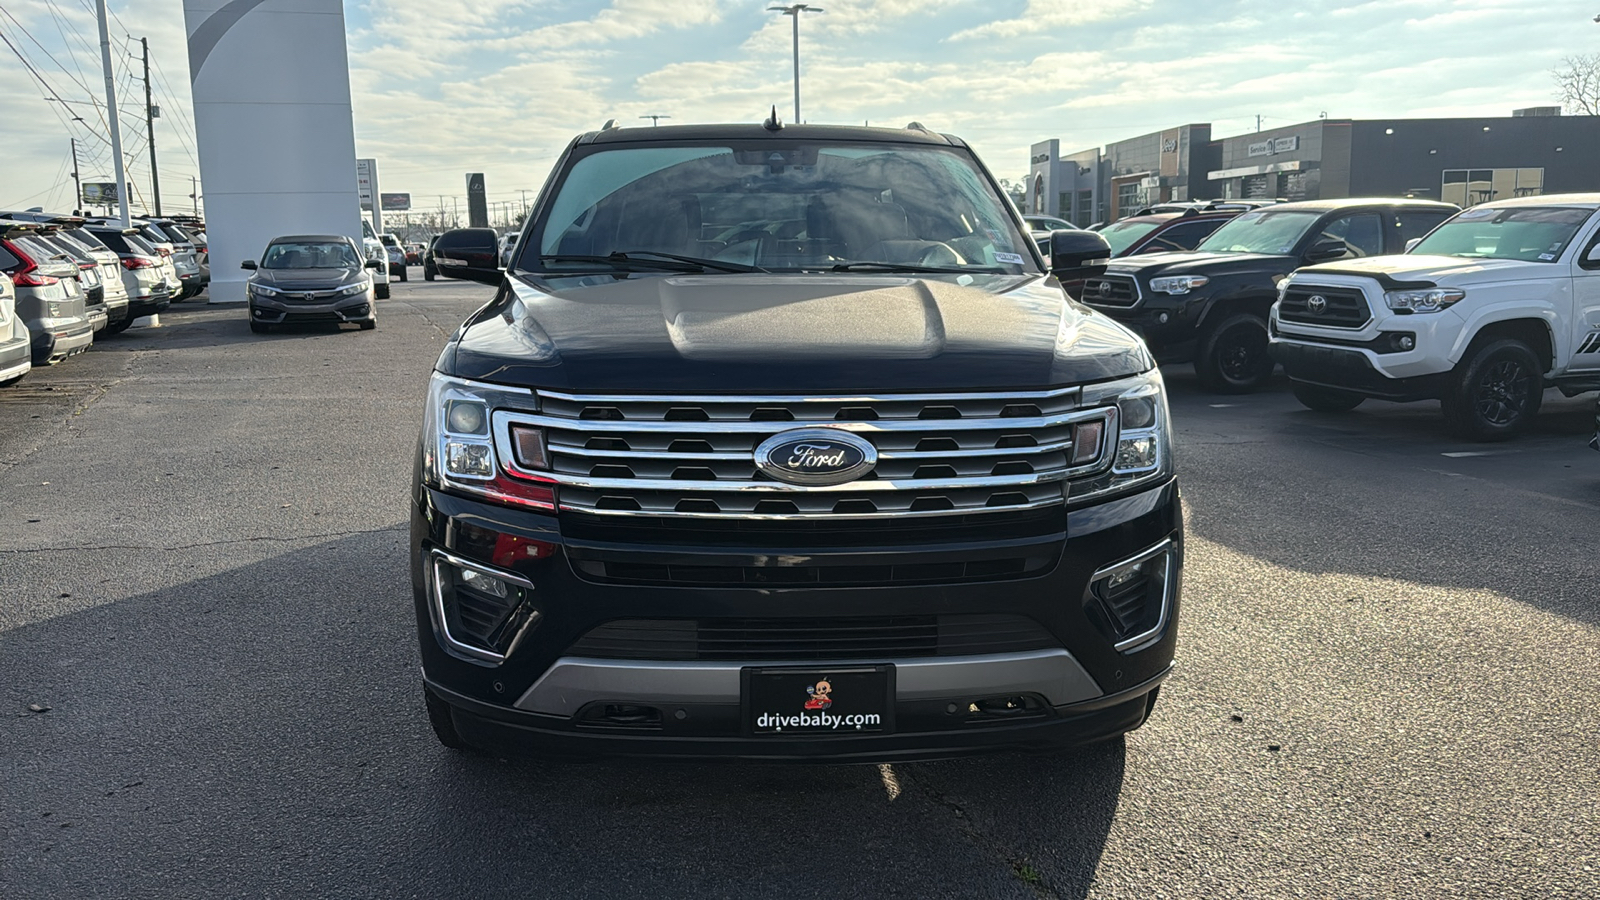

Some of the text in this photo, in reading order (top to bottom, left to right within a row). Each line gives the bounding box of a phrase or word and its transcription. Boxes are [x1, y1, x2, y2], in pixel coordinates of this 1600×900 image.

[1250, 145, 1266, 154] Service
[788, 443, 845, 468] Ford
[757, 711, 880, 730] drivebaby.com
